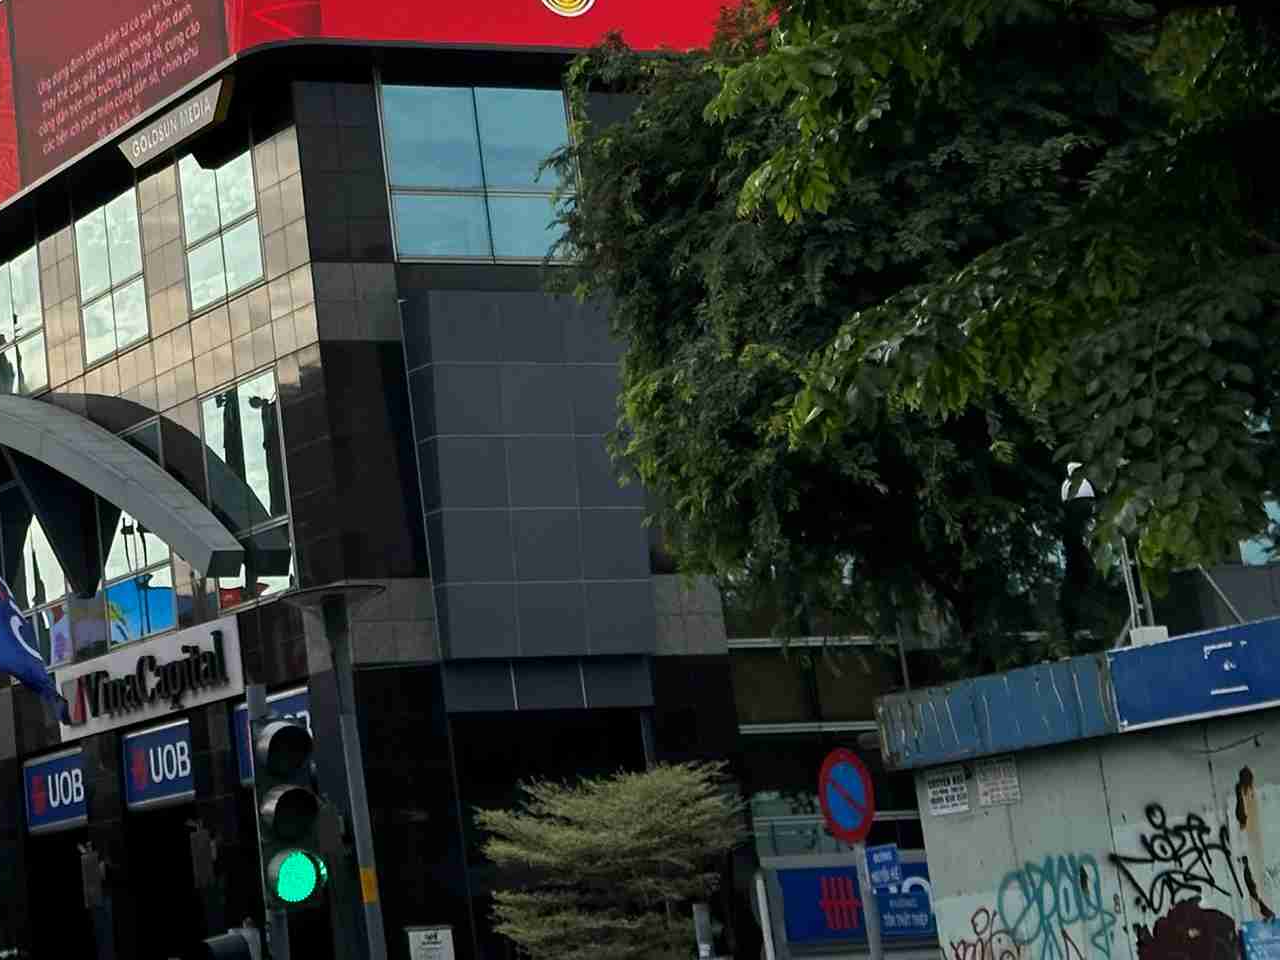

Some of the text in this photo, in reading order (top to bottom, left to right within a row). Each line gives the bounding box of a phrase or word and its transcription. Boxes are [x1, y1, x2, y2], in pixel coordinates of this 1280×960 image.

[132, 118, 178, 157] GOLDSUN
[180, 97, 211, 128] MEDIA
[85, 630, 229, 718] VinaCapital
[150, 740, 191, 783] UOB
[48, 767, 84, 808] UOB
